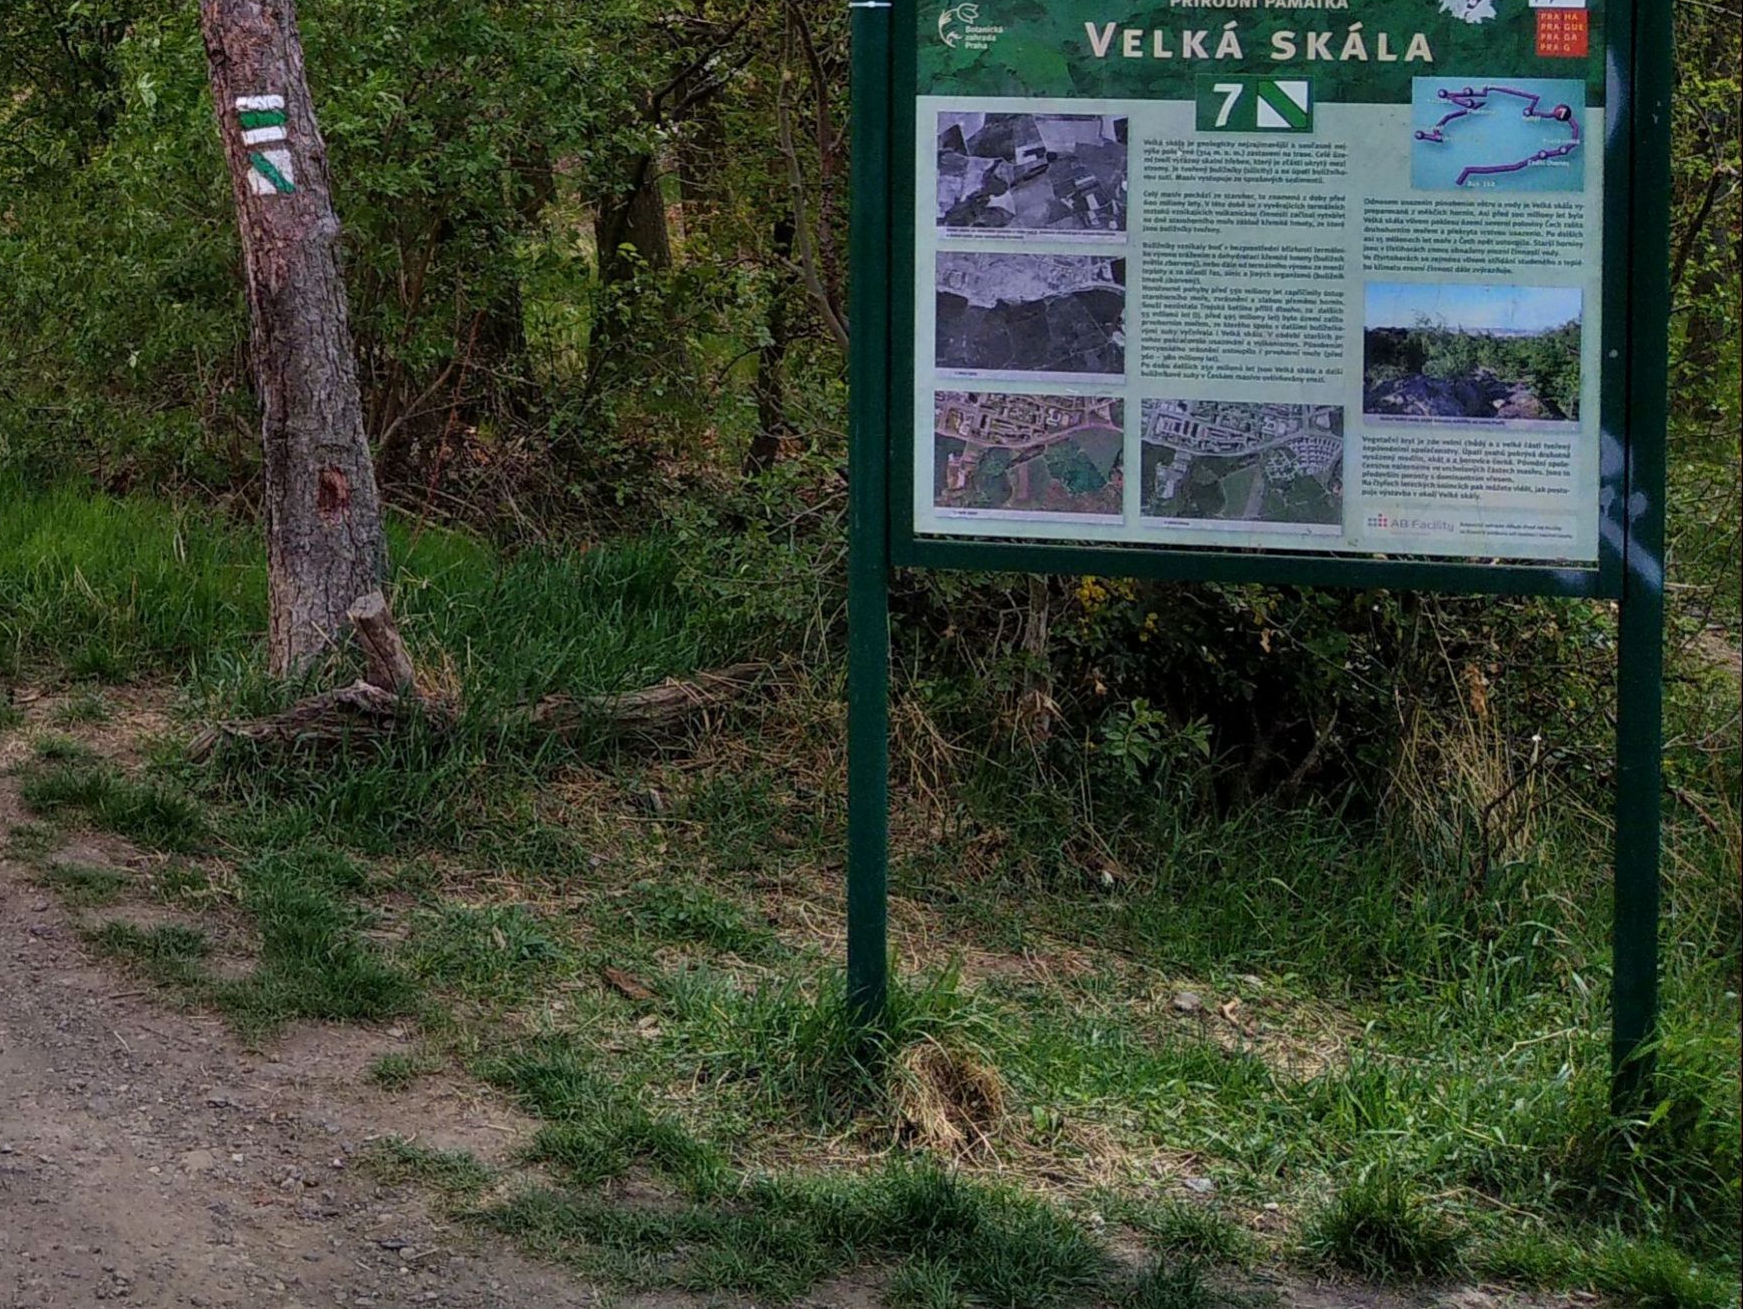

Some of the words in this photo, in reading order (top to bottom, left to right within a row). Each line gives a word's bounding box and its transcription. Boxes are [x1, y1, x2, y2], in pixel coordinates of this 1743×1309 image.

[1084, 20, 1243, 59] VELKÁ
[1270, 21, 1433, 62] SKÁLA
[1213, 83, 1243, 128] 7
